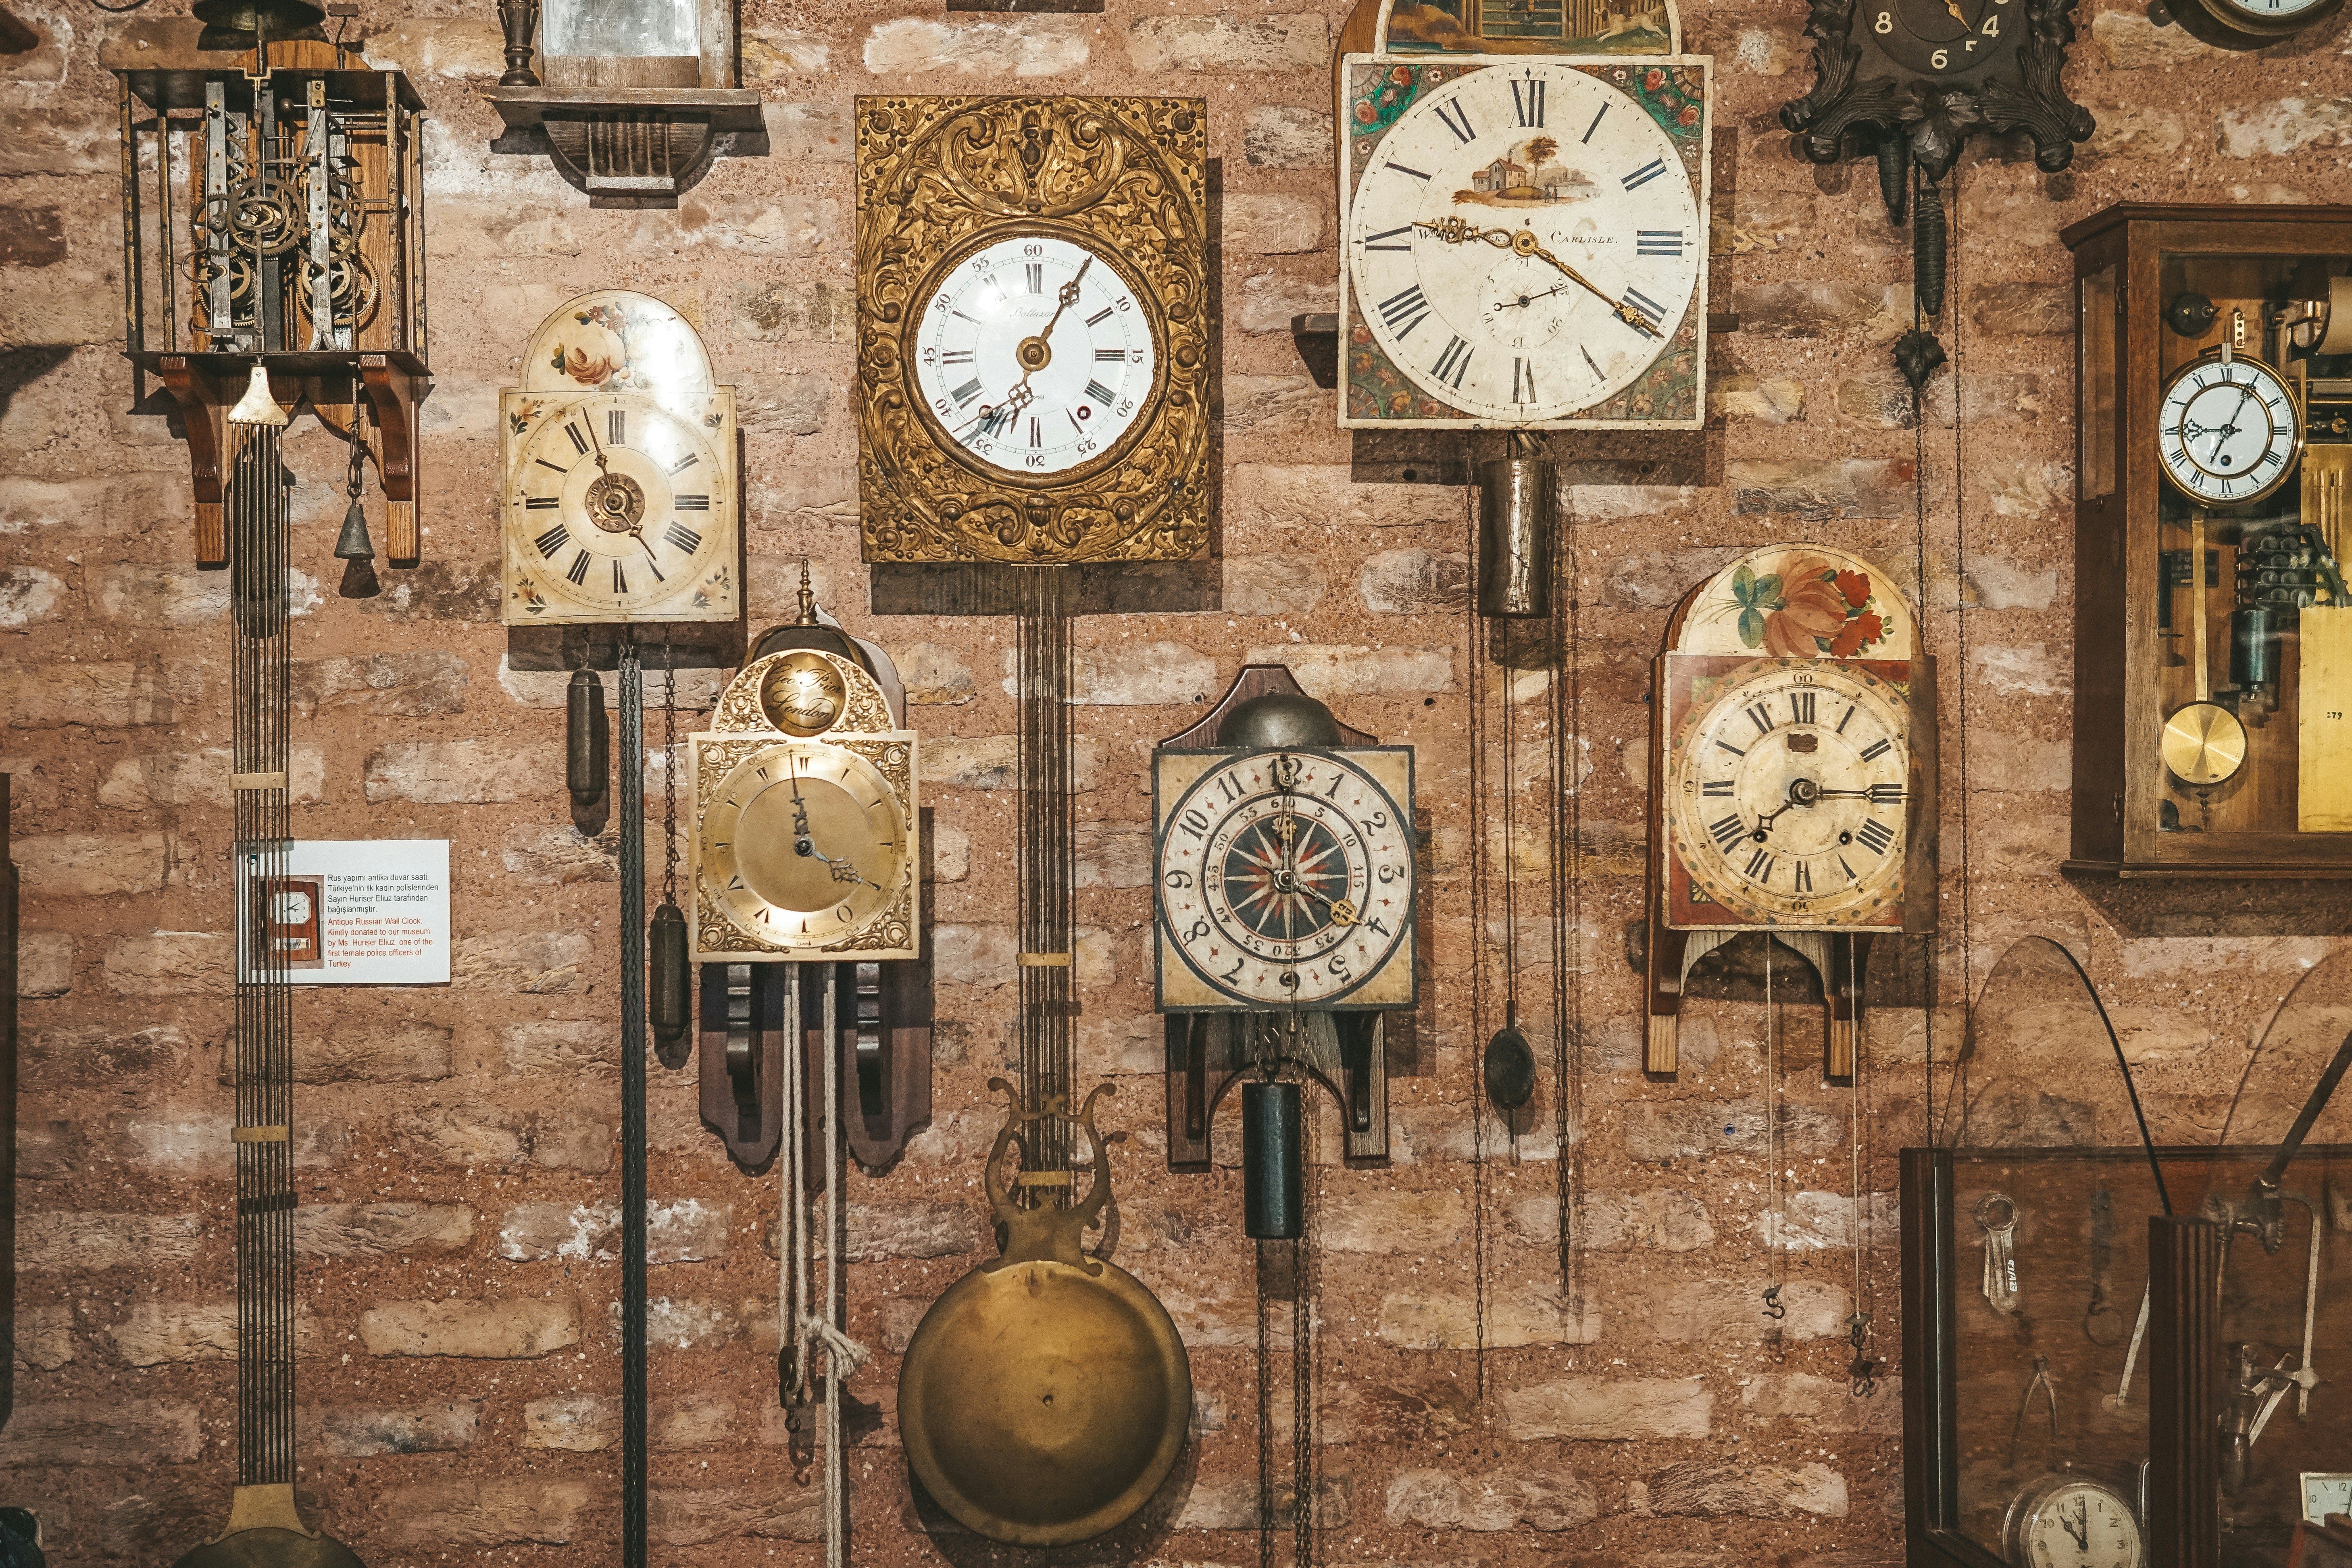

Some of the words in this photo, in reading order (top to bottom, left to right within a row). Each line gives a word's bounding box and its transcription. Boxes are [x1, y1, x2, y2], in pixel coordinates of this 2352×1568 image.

[1875, 12, 1893, 33] 8
[1982, 15, 1999, 37] 4
[1931, 49, 1947, 69] 6
[1508, 80, 1544, 128] XII
[1432, 96, 1476, 150] XI
[1581, 101, 1612, 144] I
[1384, 152, 1431, 191] X
[1620, 151, 1669, 192] II
[1365, 225, 1412, 251] IX
[1637, 228, 1682, 255] III
[1024, 244, 1042, 256] 60
[971, 254, 990, 273] 55
[1025, 264, 1043, 294] XII
[934, 294, 951, 312] 50
[1010, 307, 1055, 317] Baltazar
[1115, 295, 1131, 312] 10
[1084, 305, 1115, 328] II
[1378, 283, 1431, 344] VIII
[923, 347, 935, 367] 45
[942, 347, 973, 364] IX
[1095, 348, 1125, 363] III
[1133, 348, 1144, 364] 15
[1427, 333, 1475, 391] VII
[1580, 343, 1607, 387] V
[1510, 357, 1536, 403] VI
[2221, 369, 2232, 382] XII
[1083, 377, 1117, 408] IIII
[935, 398, 952, 418] 40
[1117, 398, 1133, 417] 20
[2268, 397, 2281, 408] II
[1066, 408, 1085, 437] V
[2274, 427, 2287, 435] III
[1029, 417, 1042, 448] VI
[975, 439, 993, 456] 35
[1077, 438, 1096, 457] 25
[1026, 455, 1045, 467] 30
[2265, 450, 2281, 466] IIII
[2221, 479, 2232, 493] VI
[675, 495, 709, 510] III
[664, 523, 702, 555] IIII
[613, 559, 628, 593] VI
[1793, 673, 1812, 683] 60
[767, 690, 835, 718] London
[1836, 706, 1855, 733] I
[2327, 712, 2342, 720] 279
[1860, 738, 1891, 762] II
[1217, 772, 1247, 804] 11
[1330, 774, 1344, 799] 1
[1683, 780, 1694, 797] 45
[1239, 807, 1257, 822] 55
[1315, 808, 1325, 818] 5
[1179, 809, 1209, 841] 10
[1360, 812, 1387, 836] 2
[1214, 833, 1229, 852] 50
[1343, 834, 1356, 846] 10
[1856, 818, 1894, 856] IIII
[1165, 870, 1193, 889] 9
[1379, 865, 1404, 883] 3
[1795, 860, 1812, 891] VI
[328, 885, 364, 893] Türkiye'nin
[328, 895, 346, 904] Sayın
[328, 906, 377, 914] bağışlanmıştır.
[1217, 907, 1231, 923] 40
[328, 918, 353, 927] Antique
[1184, 916, 1210, 945] 8
[1366, 917, 1390, 937] 4
[328, 929, 348, 937] Kindly
[1317, 934, 1335, 948] 25
[328, 939, 335, 947] by
[1243, 934, 1264, 951] 35
[367, 949, 386, 958] police
[328, 960, 352, 969] Turkey.
[1220, 958, 1245, 986] 7
[1328, 955, 1351, 983] 5
[2339, 1483, 2347, 1491] 12
[2056, 1503, 2065, 1512] 11
[2073, 1497, 2084, 1506] 12
[2098, 1503, 2102, 1512] 1
[2309, 1495, 2317, 1503] 10
[2044, 1519, 2054, 1528] 10
[2110, 1518, 2118, 1527] 2
[2038, 1541, 2047, 1550] 9
[2117, 1540, 2125, 1549] 3
